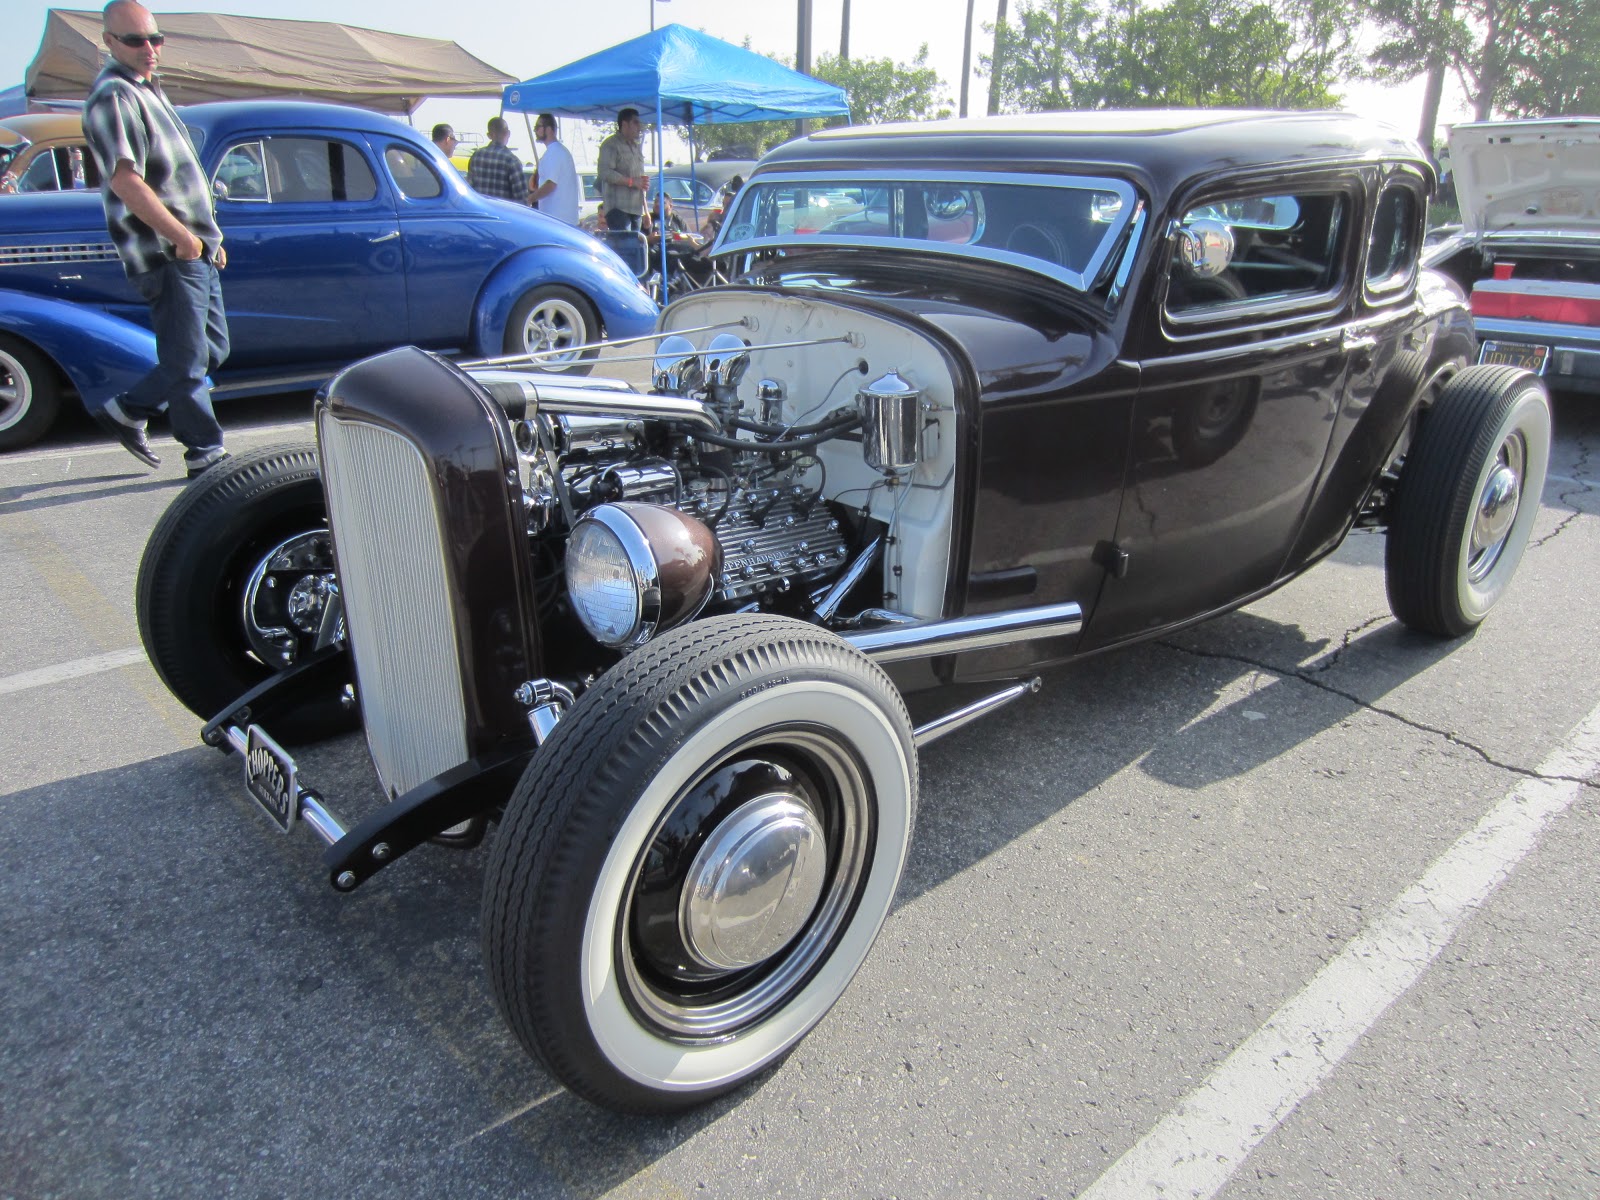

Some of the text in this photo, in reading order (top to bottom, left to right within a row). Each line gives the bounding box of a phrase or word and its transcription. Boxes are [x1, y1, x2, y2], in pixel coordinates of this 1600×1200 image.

[1517, 354, 1541, 370] 769
[723, 550, 788, 572] FFENHAUSER
[247, 747, 289, 815] CHOPPERS
